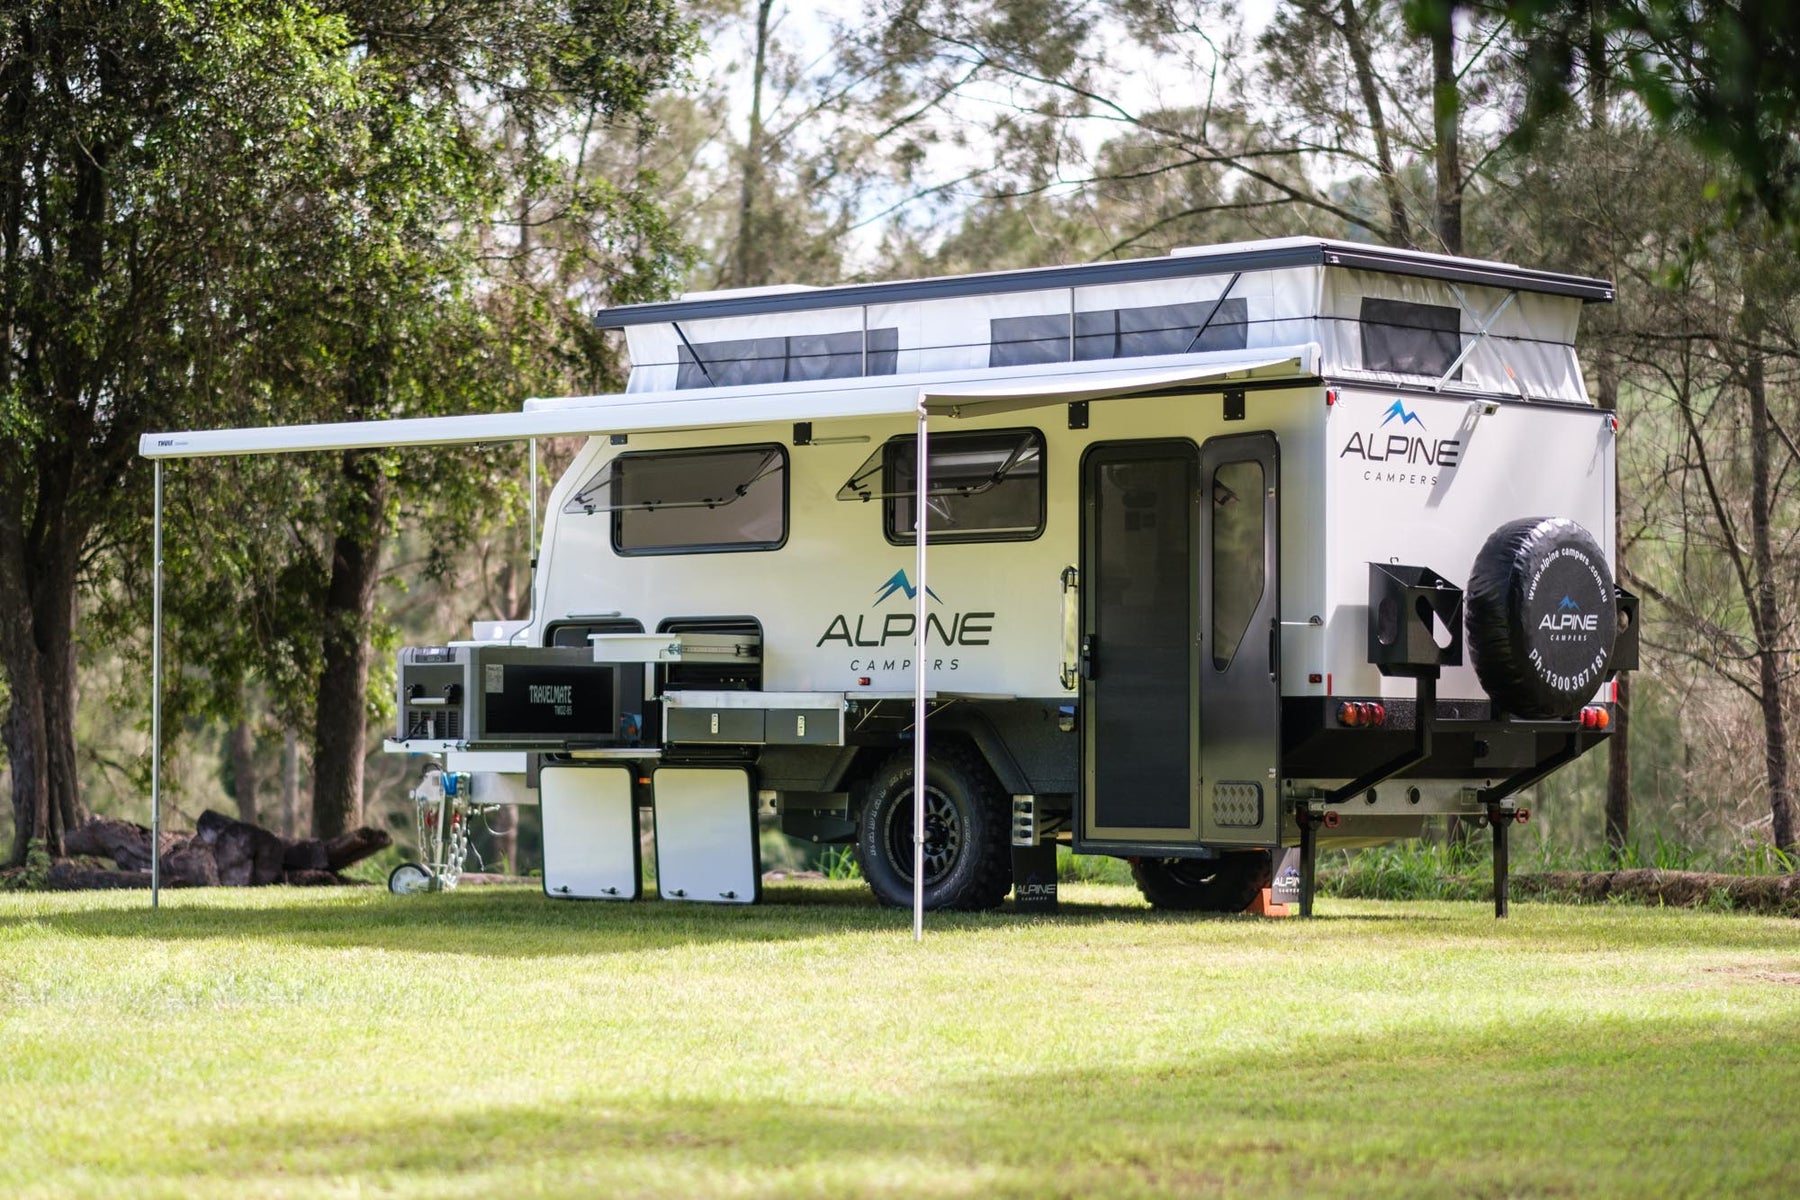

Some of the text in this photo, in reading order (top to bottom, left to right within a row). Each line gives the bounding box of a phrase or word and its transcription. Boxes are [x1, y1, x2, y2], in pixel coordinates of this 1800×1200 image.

[1340, 431, 1460, 467] ALPINE
[1363, 471, 1439, 486] CAMPERS
[816, 612, 995, 647] ALPNE
[1538, 613, 1599, 631] ALPINE
[850, 659, 960, 671] CAMPRS
[1572, 668, 1589, 691] 367
[529, 685, 572, 704] TRAVELMATE
[1016, 884, 1056, 894] ALPINE
